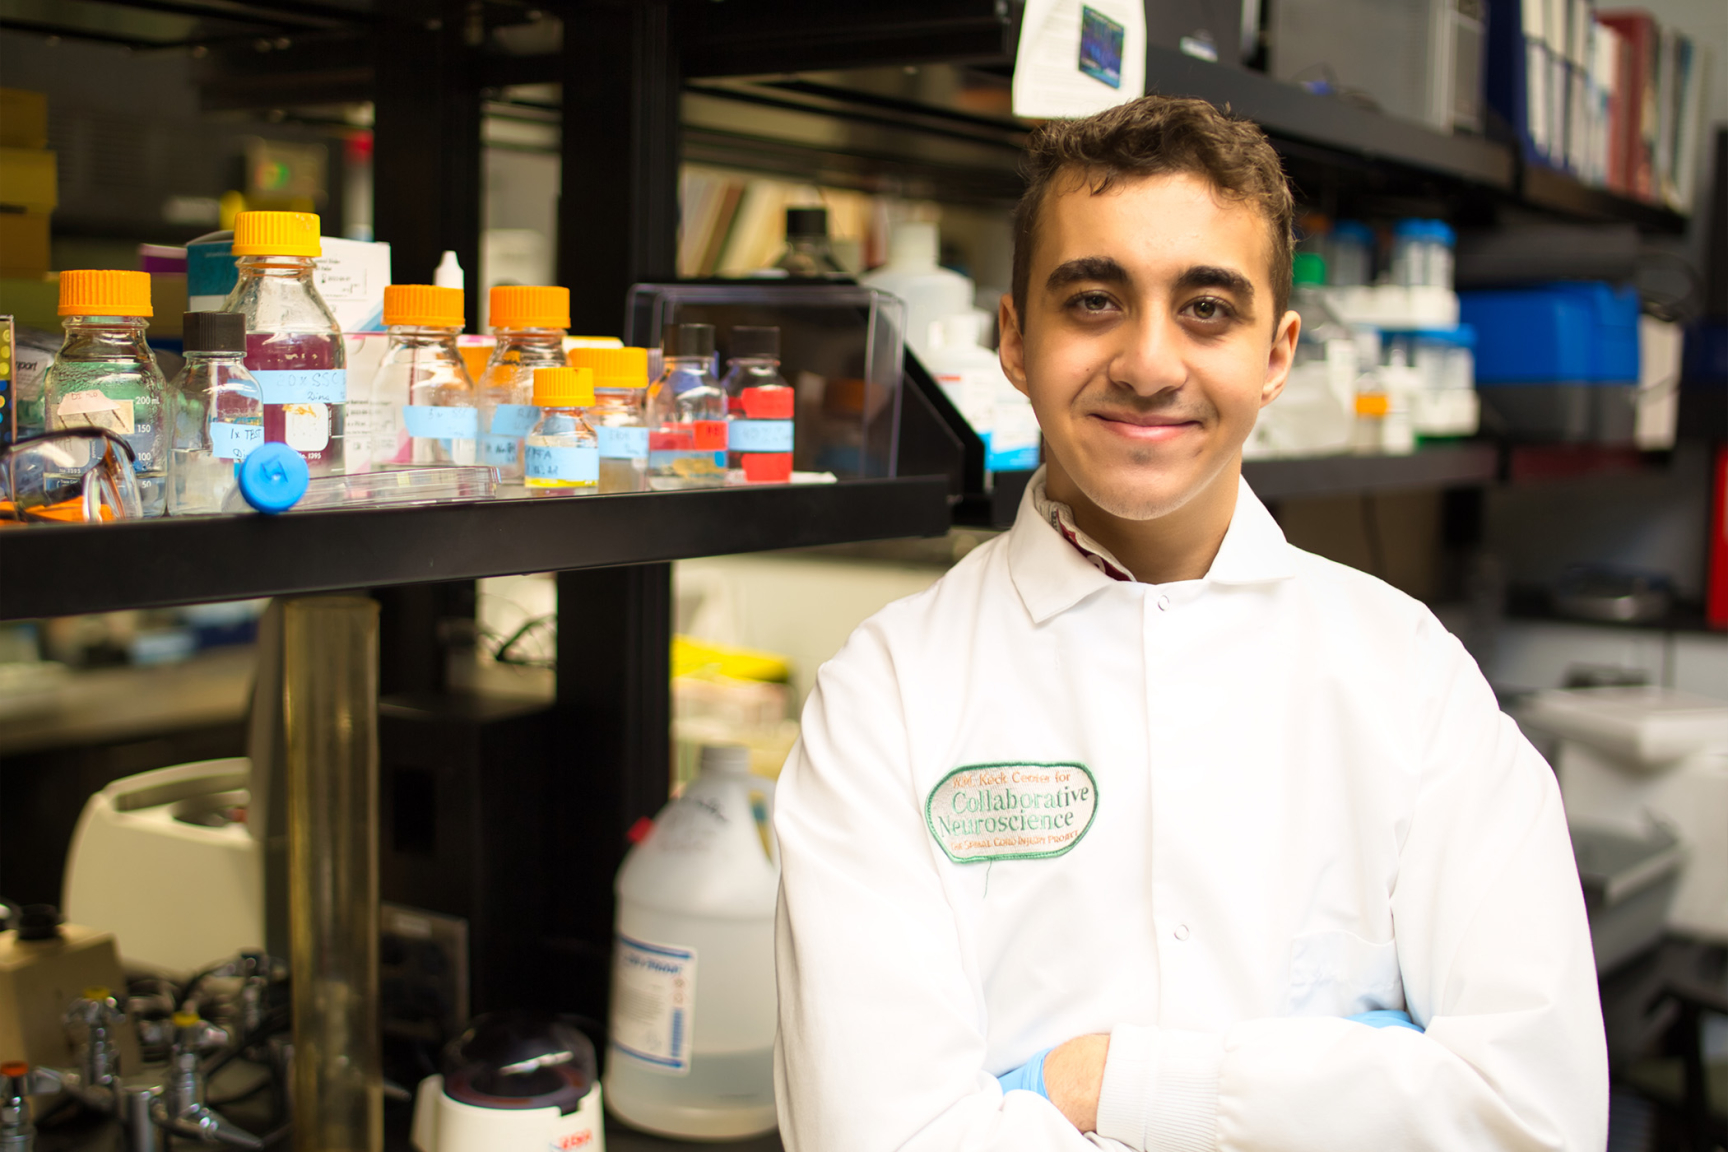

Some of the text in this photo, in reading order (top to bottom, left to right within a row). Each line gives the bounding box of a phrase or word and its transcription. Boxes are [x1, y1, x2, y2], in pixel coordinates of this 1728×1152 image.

[135, 396, 150, 405] 200
[137, 424, 151, 433] 150
[137, 452, 151, 461] 100
[141, 480, 152, 489] 50
[979, 772, 1008, 786] Keck
[1055, 771, 1071, 783] for
[951, 786, 1089, 815] Collaborative
[938, 810, 1074, 838] Neuroscience
